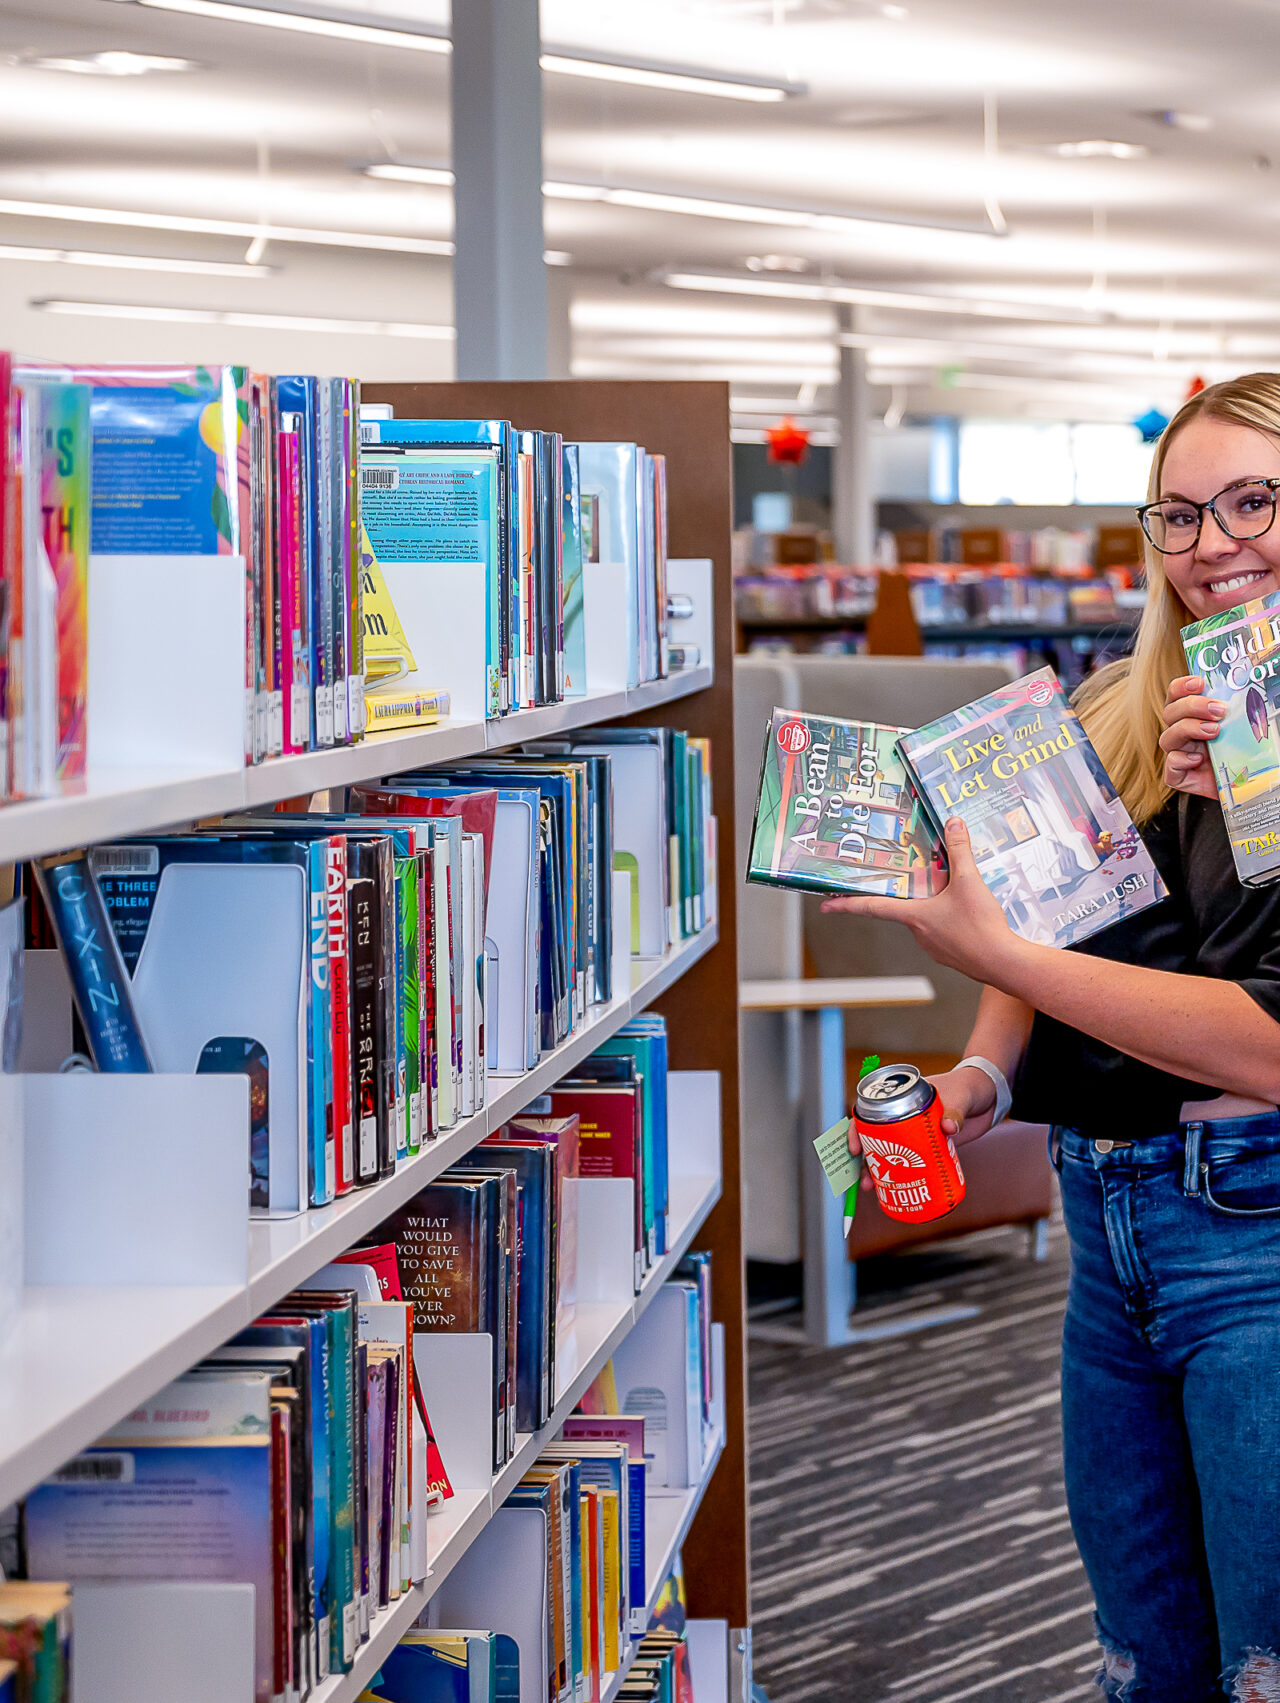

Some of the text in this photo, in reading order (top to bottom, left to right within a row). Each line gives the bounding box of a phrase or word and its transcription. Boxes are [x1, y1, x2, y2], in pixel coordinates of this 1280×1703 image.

[1197, 627, 1266, 672] Cold
[943, 714, 1044, 774] Live and
[936, 773, 991, 809] Let
[991, 724, 1078, 780] Grind
[790, 742, 831, 856] A Bean
[825, 794, 844, 820] to
[838, 742, 880, 863] Die For
[117, 882, 156, 892] THREE
[109, 897, 149, 907] OBLEM
[327, 847, 346, 959] EARTH
[1053, 873, 1149, 930] TARA LUSH
[57, 875, 121, 1013] CIXIN
[311, 892, 328, 991] END
[892, 1178, 926, 1190] LIBRARIES
[889, 1185, 932, 1207] TOUR
[408, 1217, 449, 1228] WHAT
[403, 1231, 453, 1242] WOULD
[396, 1245, 459, 1256] YOU GIVE
[400, 1259, 454, 1270] TO SAVE
[414, 1274, 439, 1283] ALL
[403, 1286, 452, 1298] YOU'VE
[413, 1301, 444, 1311] EVER
[413, 1314, 456, 1325] NOWN?
